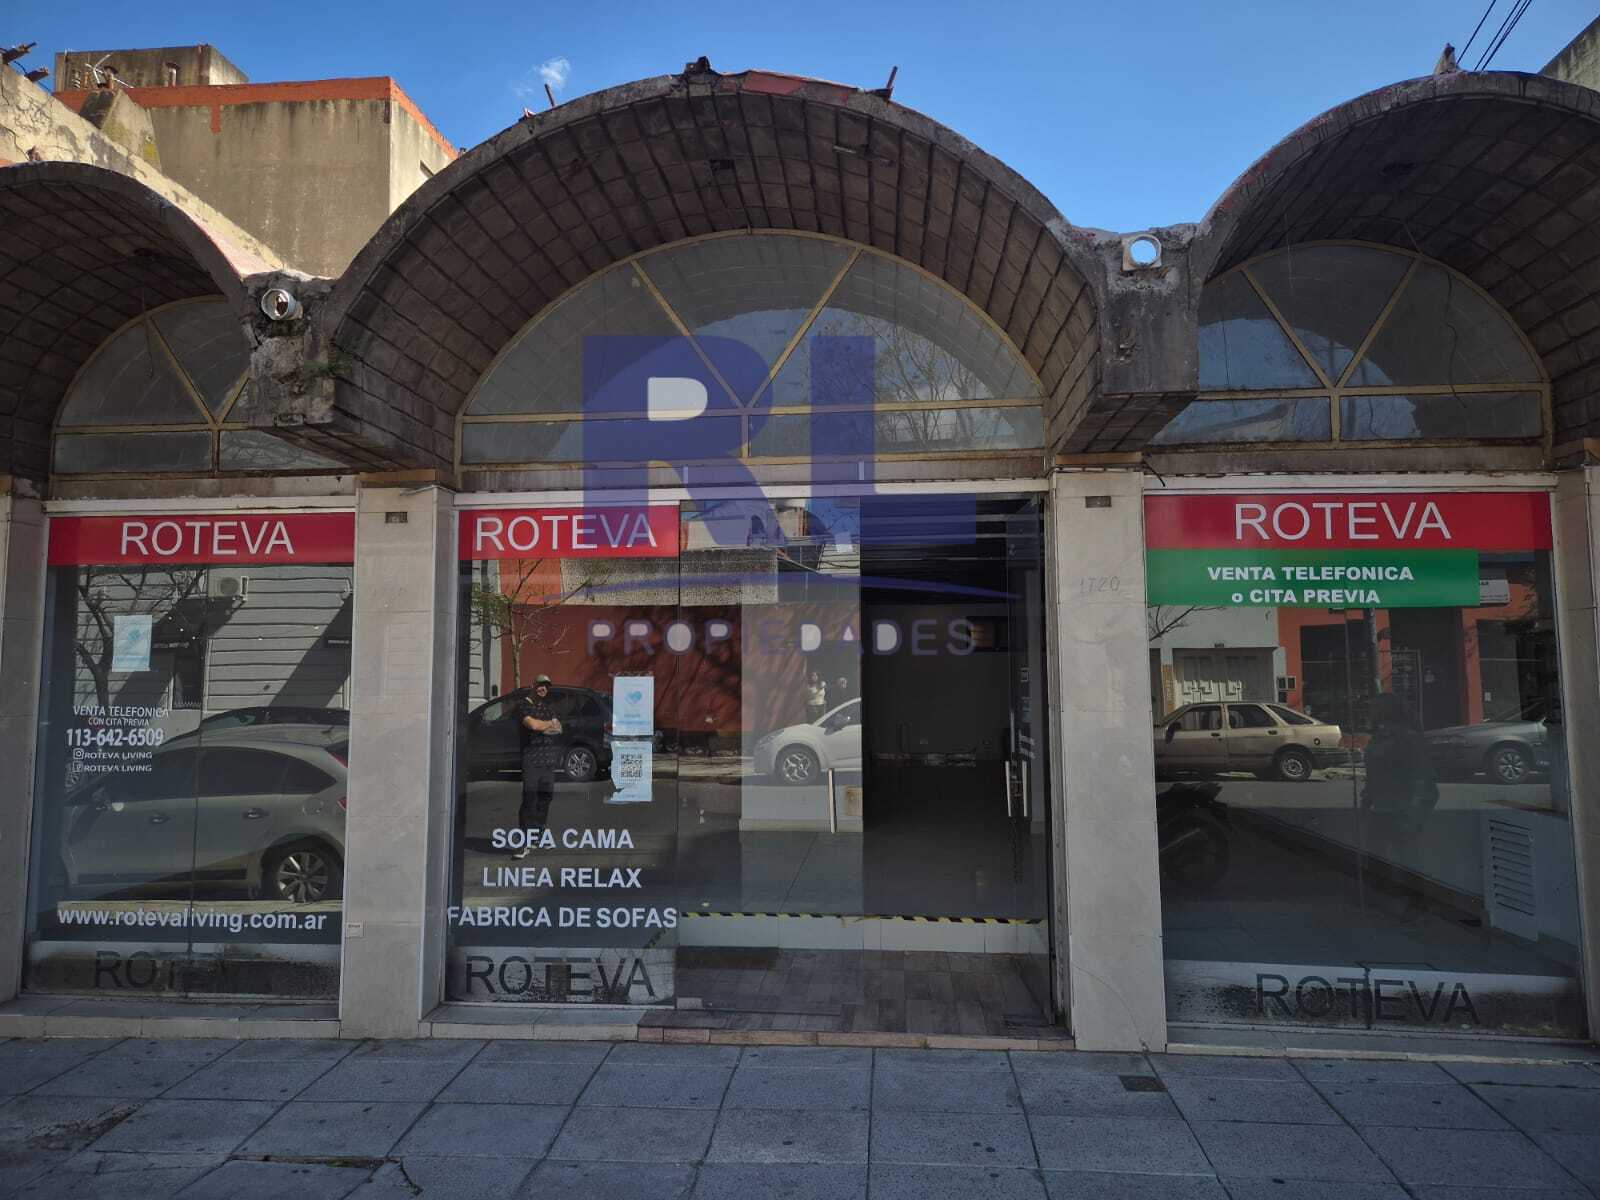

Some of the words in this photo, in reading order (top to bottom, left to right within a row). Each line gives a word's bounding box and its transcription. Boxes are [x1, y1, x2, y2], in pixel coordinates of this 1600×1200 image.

[1235, 501, 1452, 541] ROTEVA
[120, 521, 295, 556] ROTEVA
[475, 513, 657, 552] ROTEVA
[1207, 566, 1275, 582] VENTA
[1281, 566, 1414, 582] TELEFONICA
[1249, 588, 1297, 604] CITA
[1303, 588, 1380, 604] PREVIA
[73, 705, 106, 716] VENTA
[108, 705, 169, 718] TELEFONICA
[88, 717, 105, 726] CON
[105, 718, 122, 727] CITA
[124, 718, 150, 727] PREVIA
[66, 728, 164, 747] 113-642-6509
[84, 751, 119, 760] ROTEVA
[122, 751, 153, 760] LIVING
[84, 764, 119, 773] ROTEVA
[122, 764, 152, 773] LIVING
[491, 828, 556, 849] SOFA
[562, 828, 635, 849] CAMA
[483, 867, 554, 888] LINEA
[560, 867, 642, 889] RELAX
[58, 908, 327, 933] www.rotevaliving.com.ar
[447, 906, 552, 928] FABRICA
[558, 907, 591, 928] DE
[596, 907, 678, 929] SOFAS
[465, 955, 656, 997] ROTEVA
[1255, 972, 1481, 1025] ROTEVA
